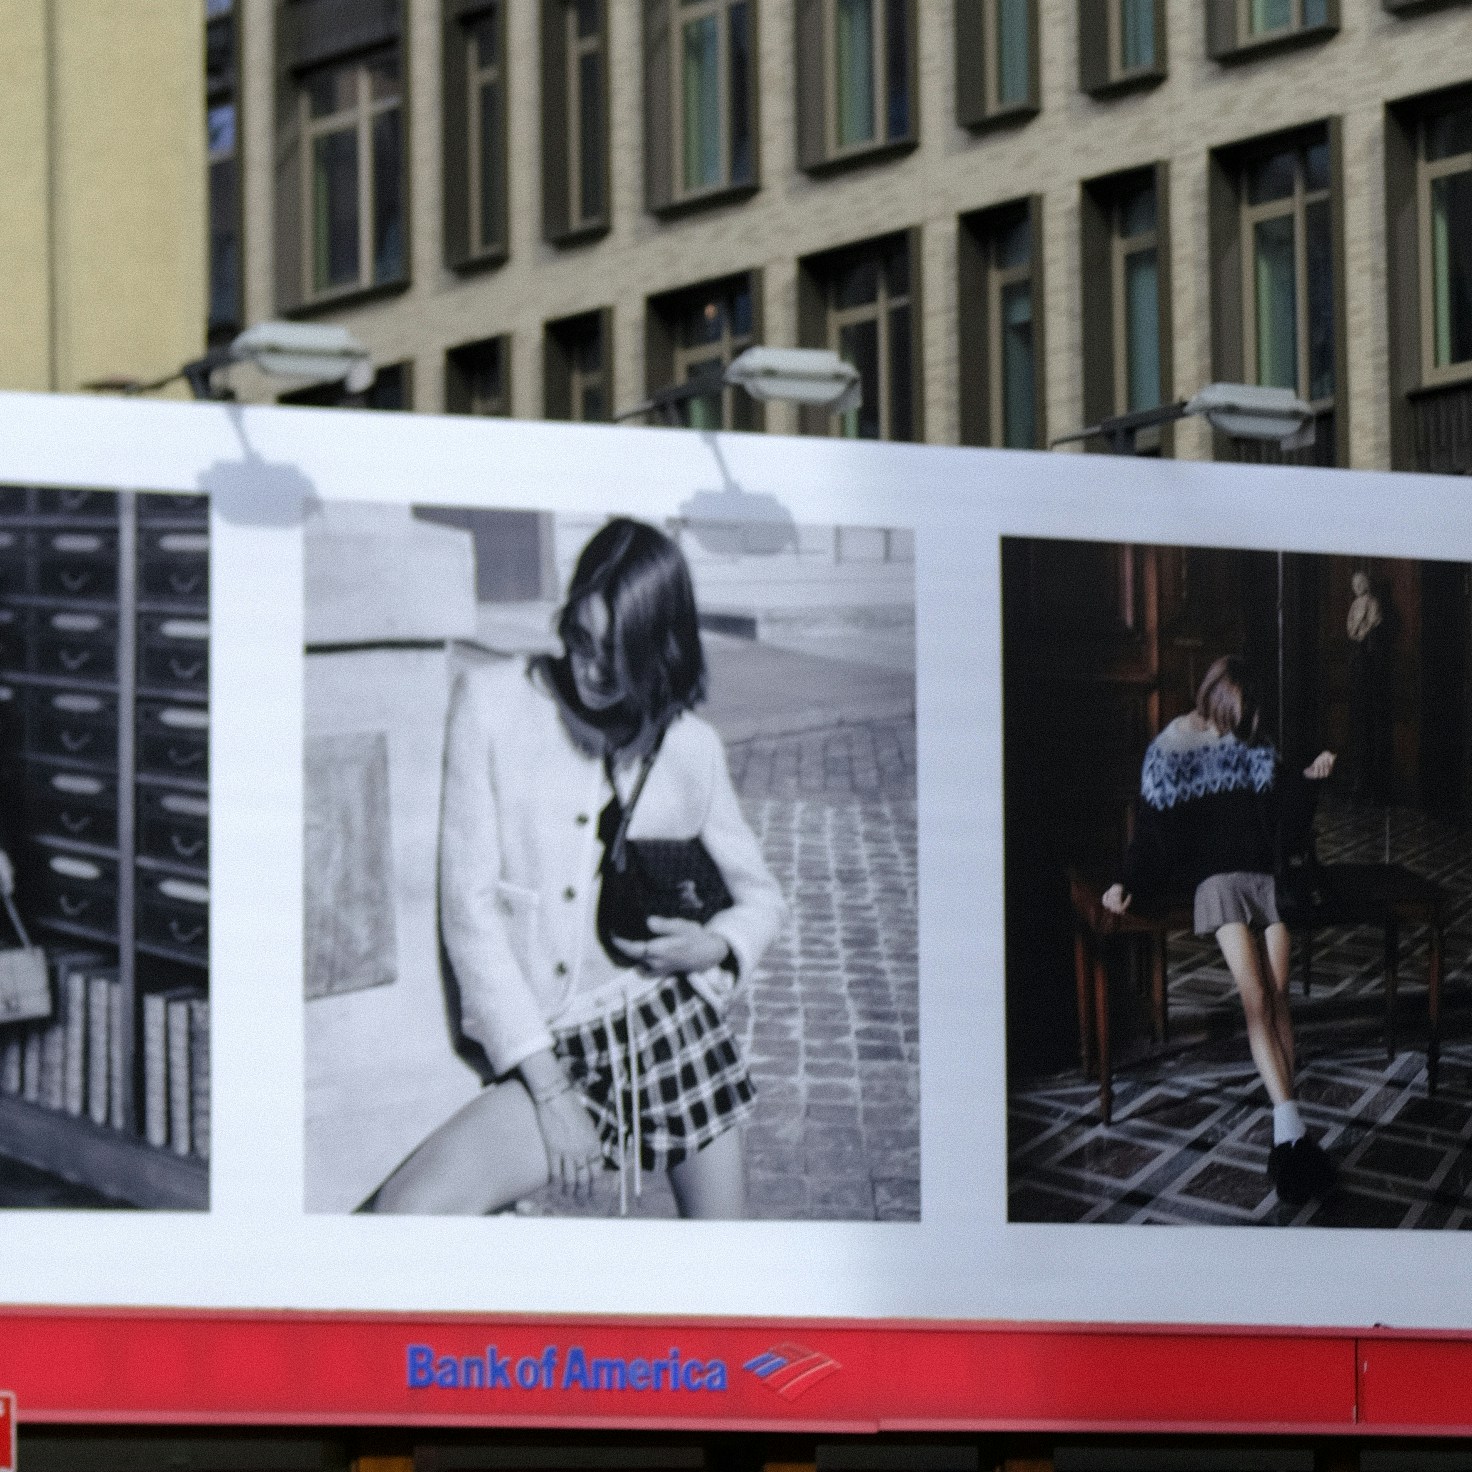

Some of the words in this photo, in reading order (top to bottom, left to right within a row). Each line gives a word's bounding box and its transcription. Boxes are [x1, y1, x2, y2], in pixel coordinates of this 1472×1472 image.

[406, 1343, 512, 1389] Bank
[515, 1344, 558, 1389] of
[561, 1346, 728, 1392] America
